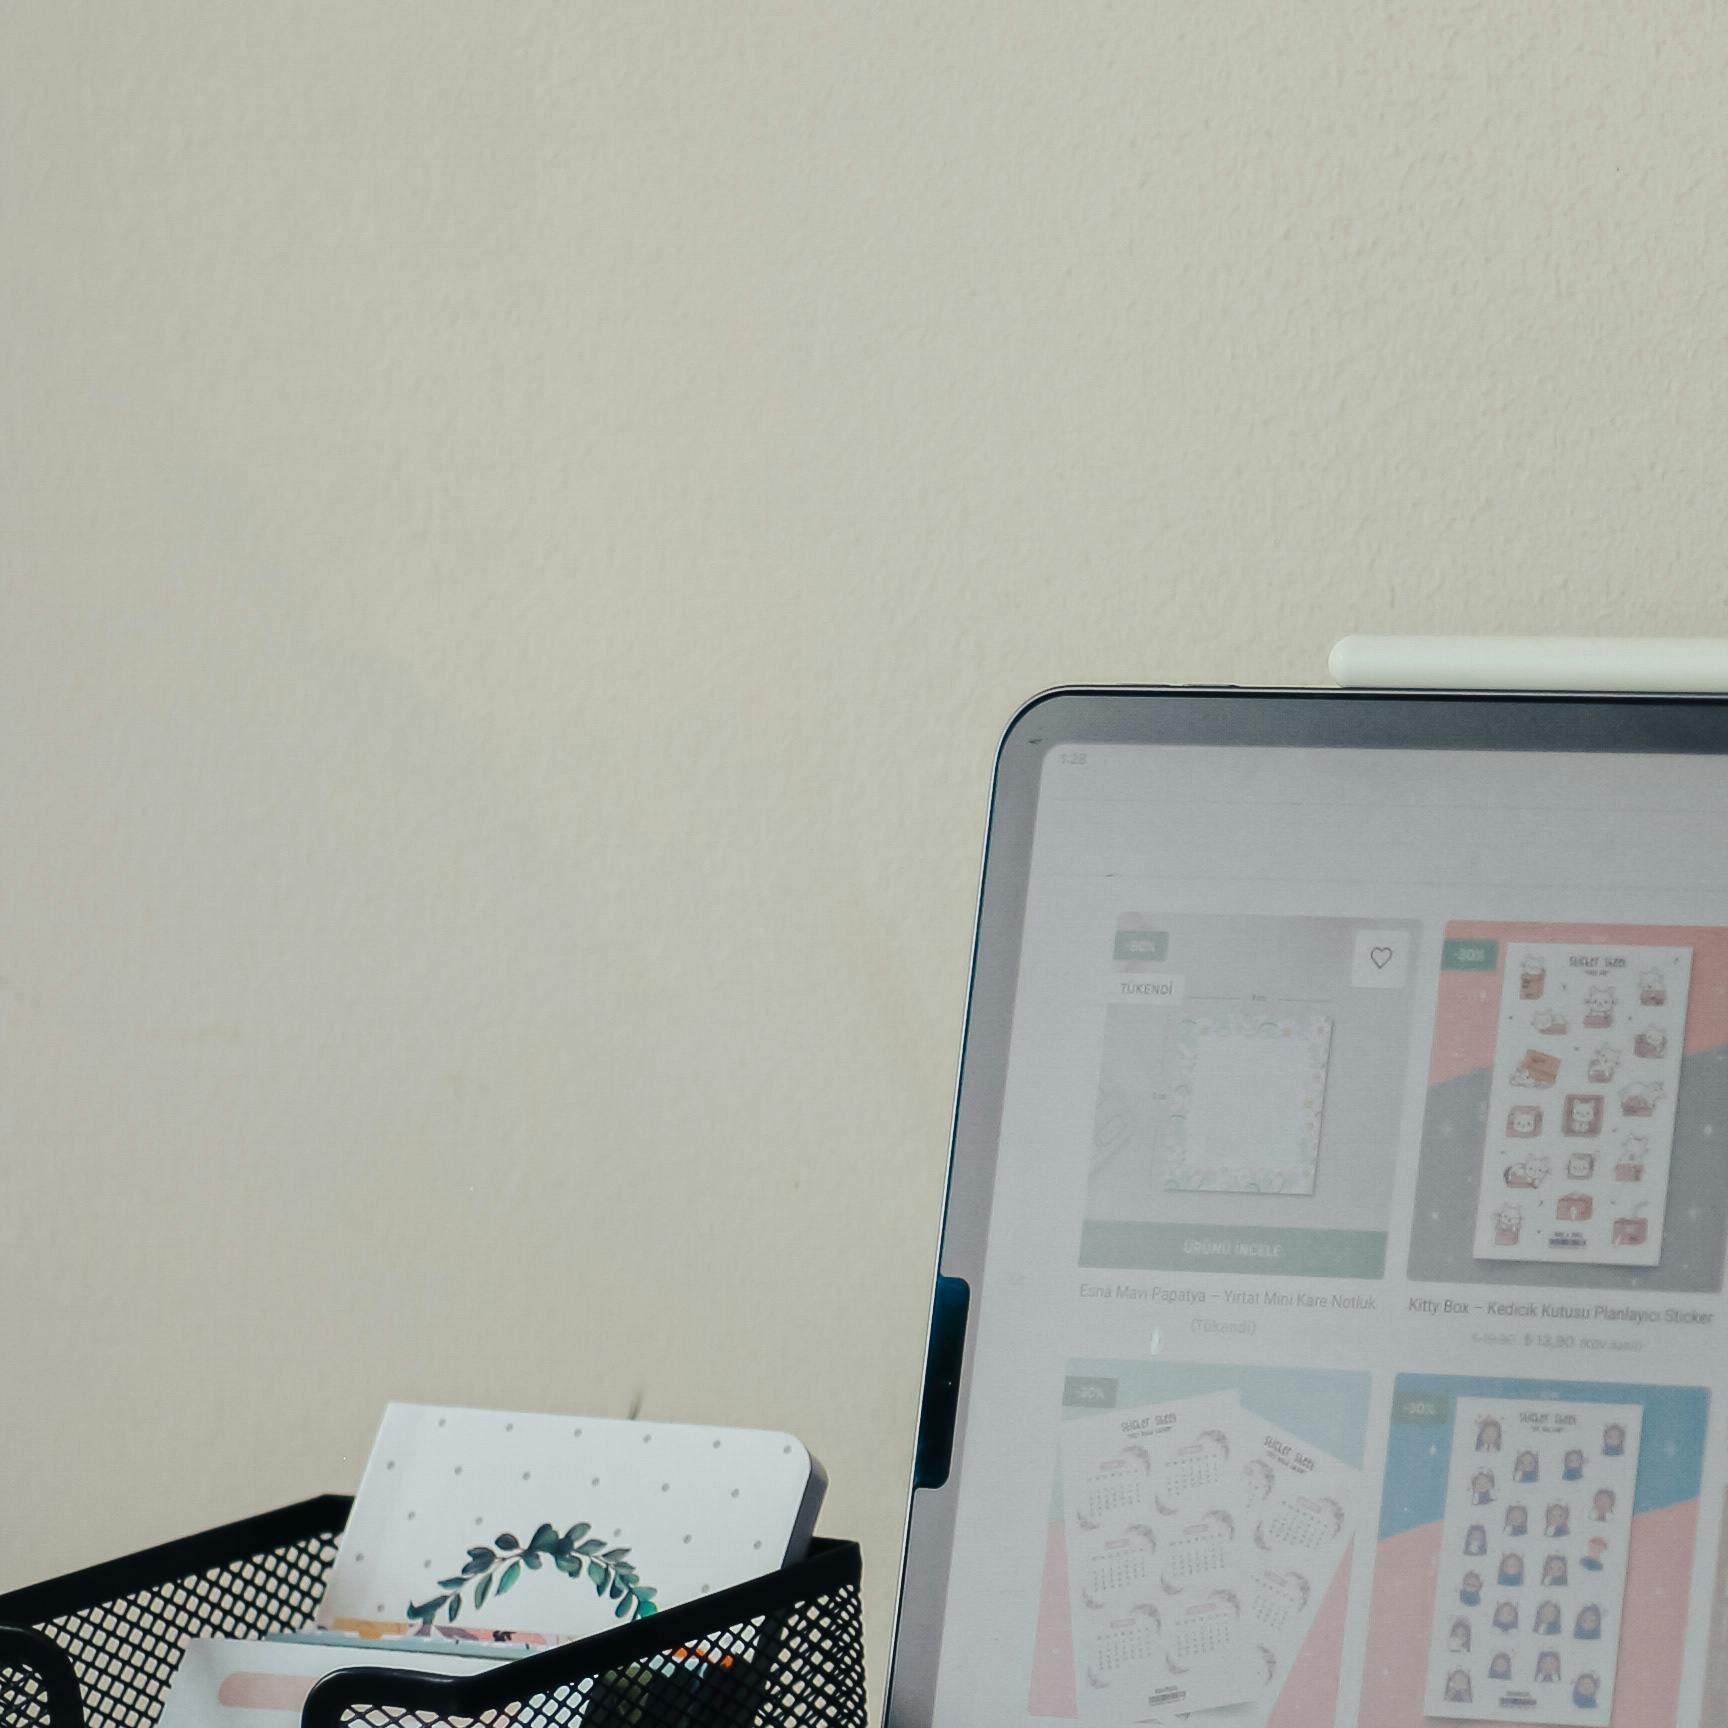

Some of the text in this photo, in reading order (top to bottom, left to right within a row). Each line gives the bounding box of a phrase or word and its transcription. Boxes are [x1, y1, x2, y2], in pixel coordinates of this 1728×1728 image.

[1152, 1287, 1206, 1305] Papatya
[1296, 1294, 1327, 1308] Kare
[1331, 1295, 1376, 1310] Notluk
[1408, 1297, 1440, 1316] Kitty
[1443, 1299, 1469, 1314] Box
[1541, 1304, 1590, 1319] Kutusu
[1663, 1308, 1715, 1324] Sticker
